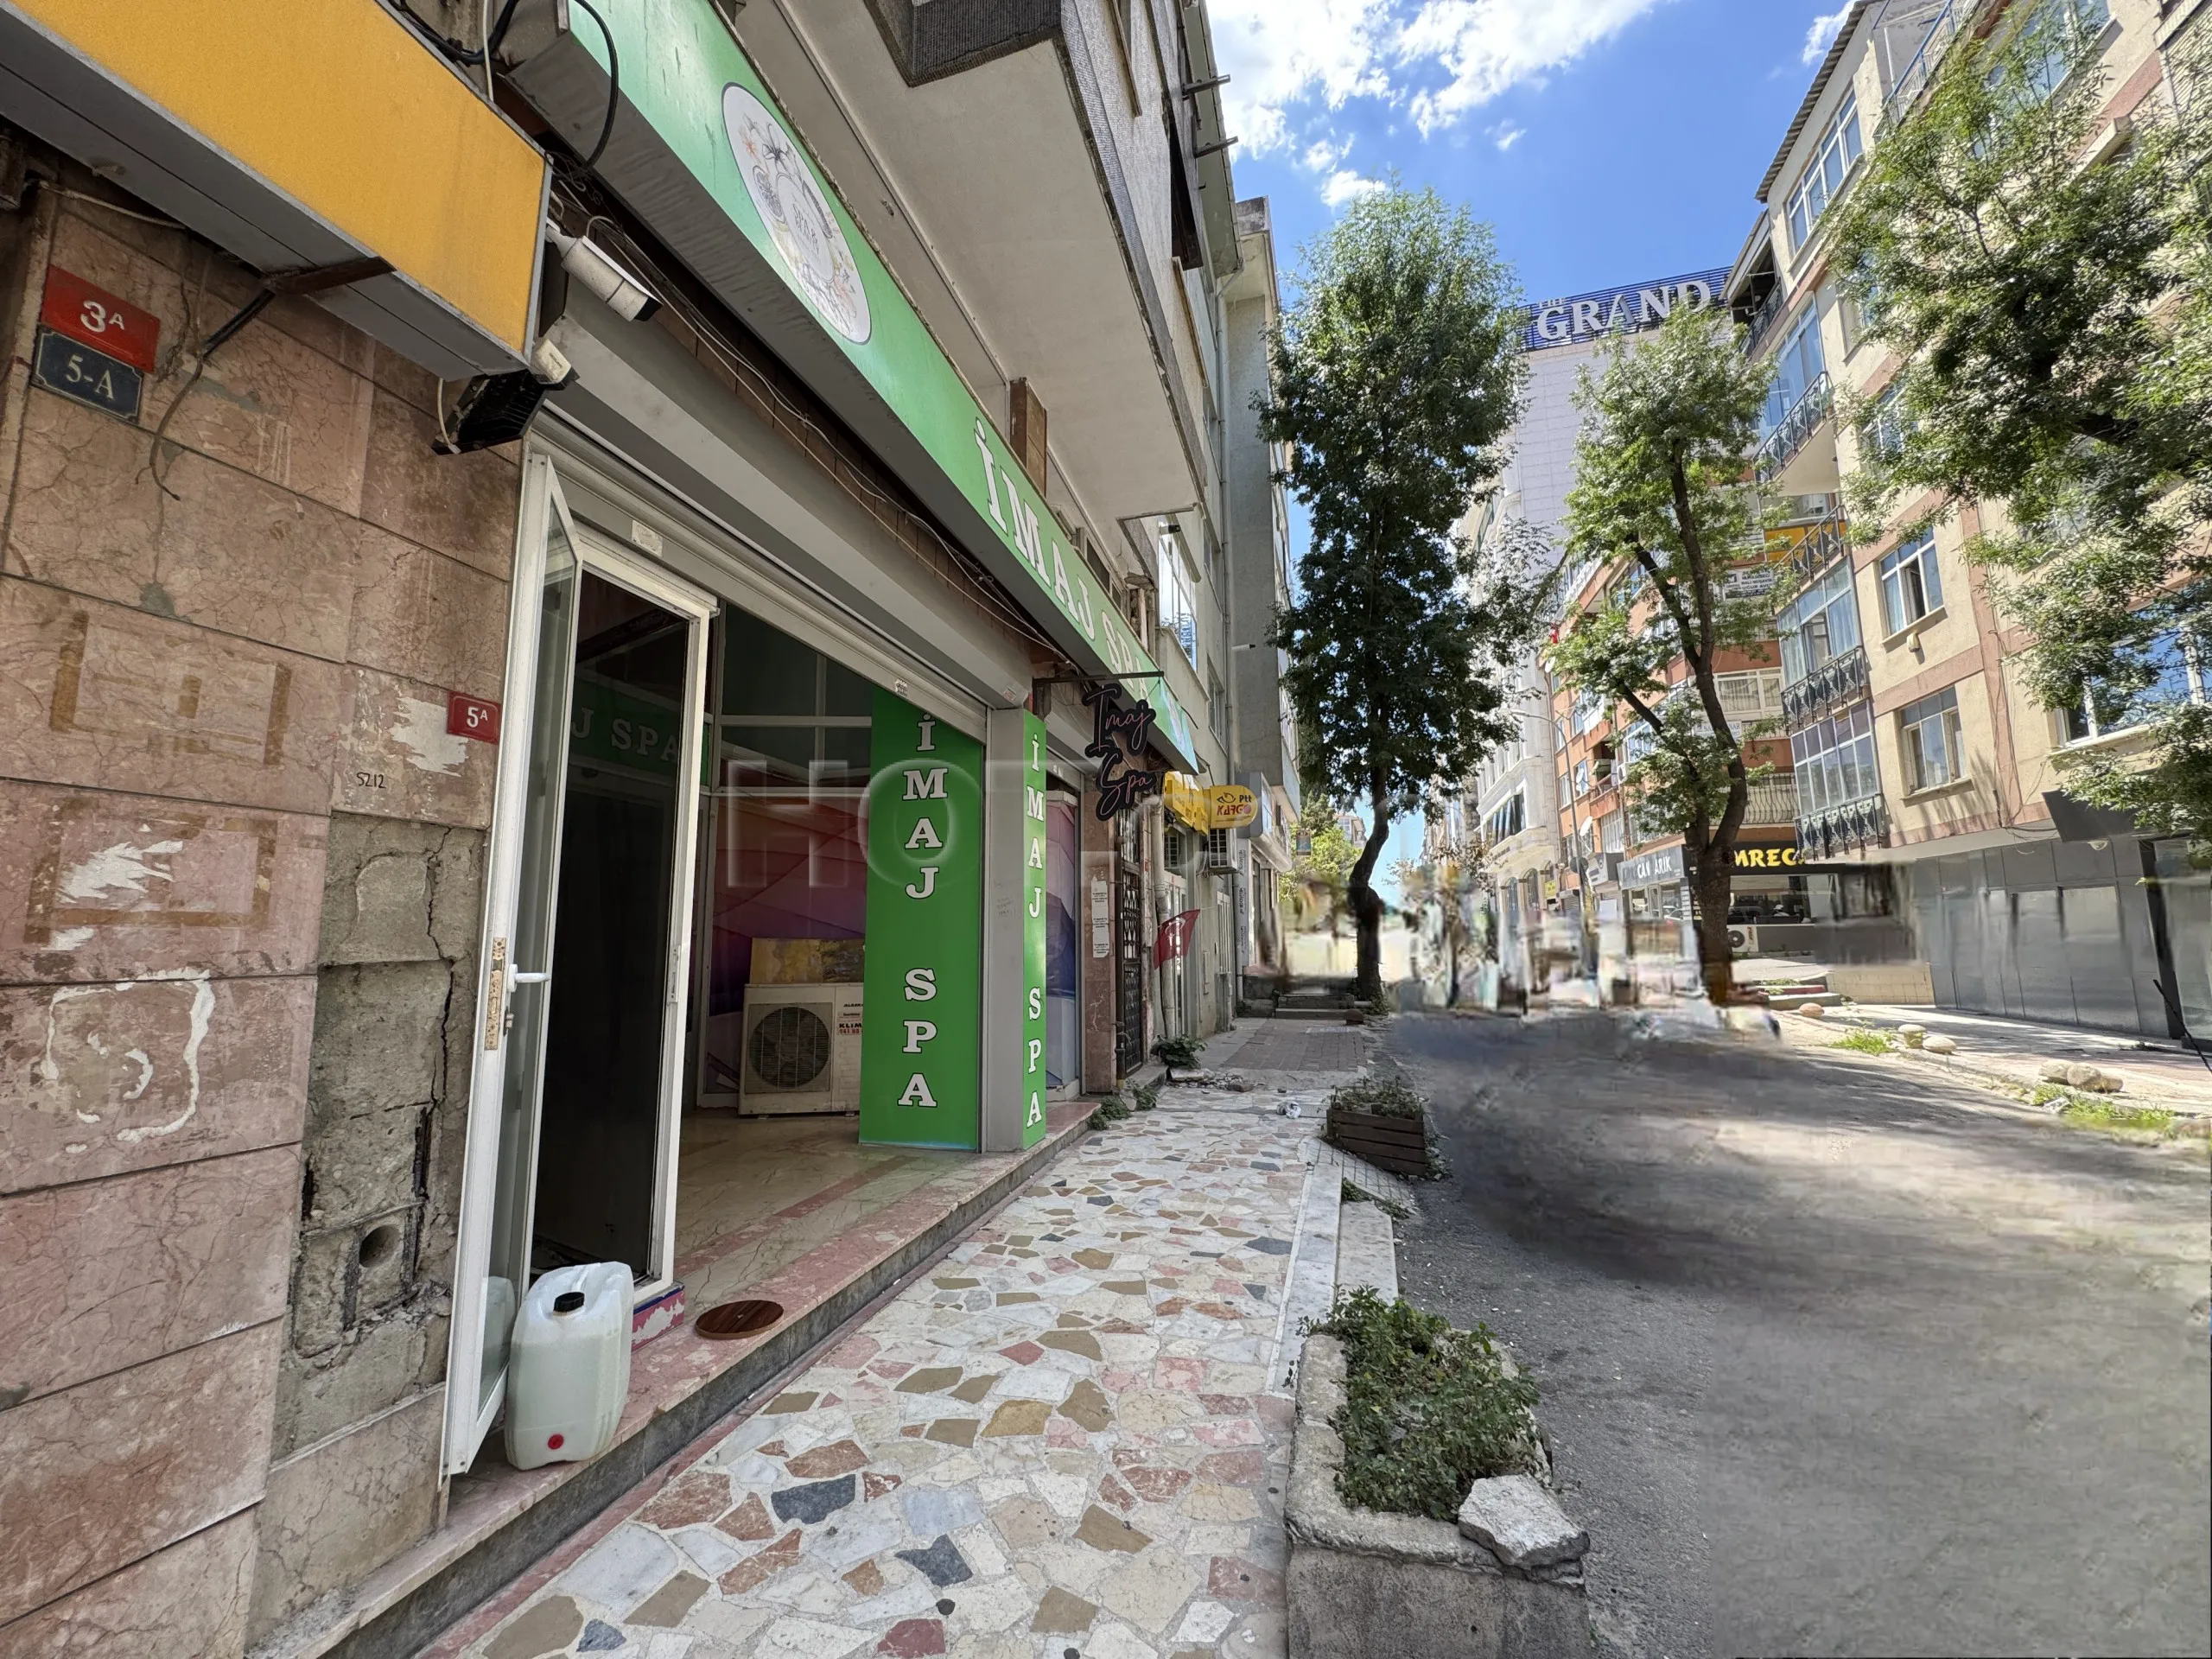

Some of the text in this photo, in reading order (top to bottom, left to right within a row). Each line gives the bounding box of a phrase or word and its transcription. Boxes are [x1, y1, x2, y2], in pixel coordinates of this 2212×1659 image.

[80, 301, 124, 333] 3A
[1536, 280, 1711, 340] GRAND
[66, 354, 115, 400] 5-A
[974, 416, 1152, 709] İMAJ SPA
[467, 706, 488, 728] 5A
[611, 717, 678, 762] SPA
[1100, 753, 1153, 816] Spa
[1216, 804, 1252, 817] KARGO
[1734, 848, 1804, 868] MREC
[898, 713, 949, 1108] İMAJ SPA
[1026, 734, 1045, 1128] İMAJ SPA
